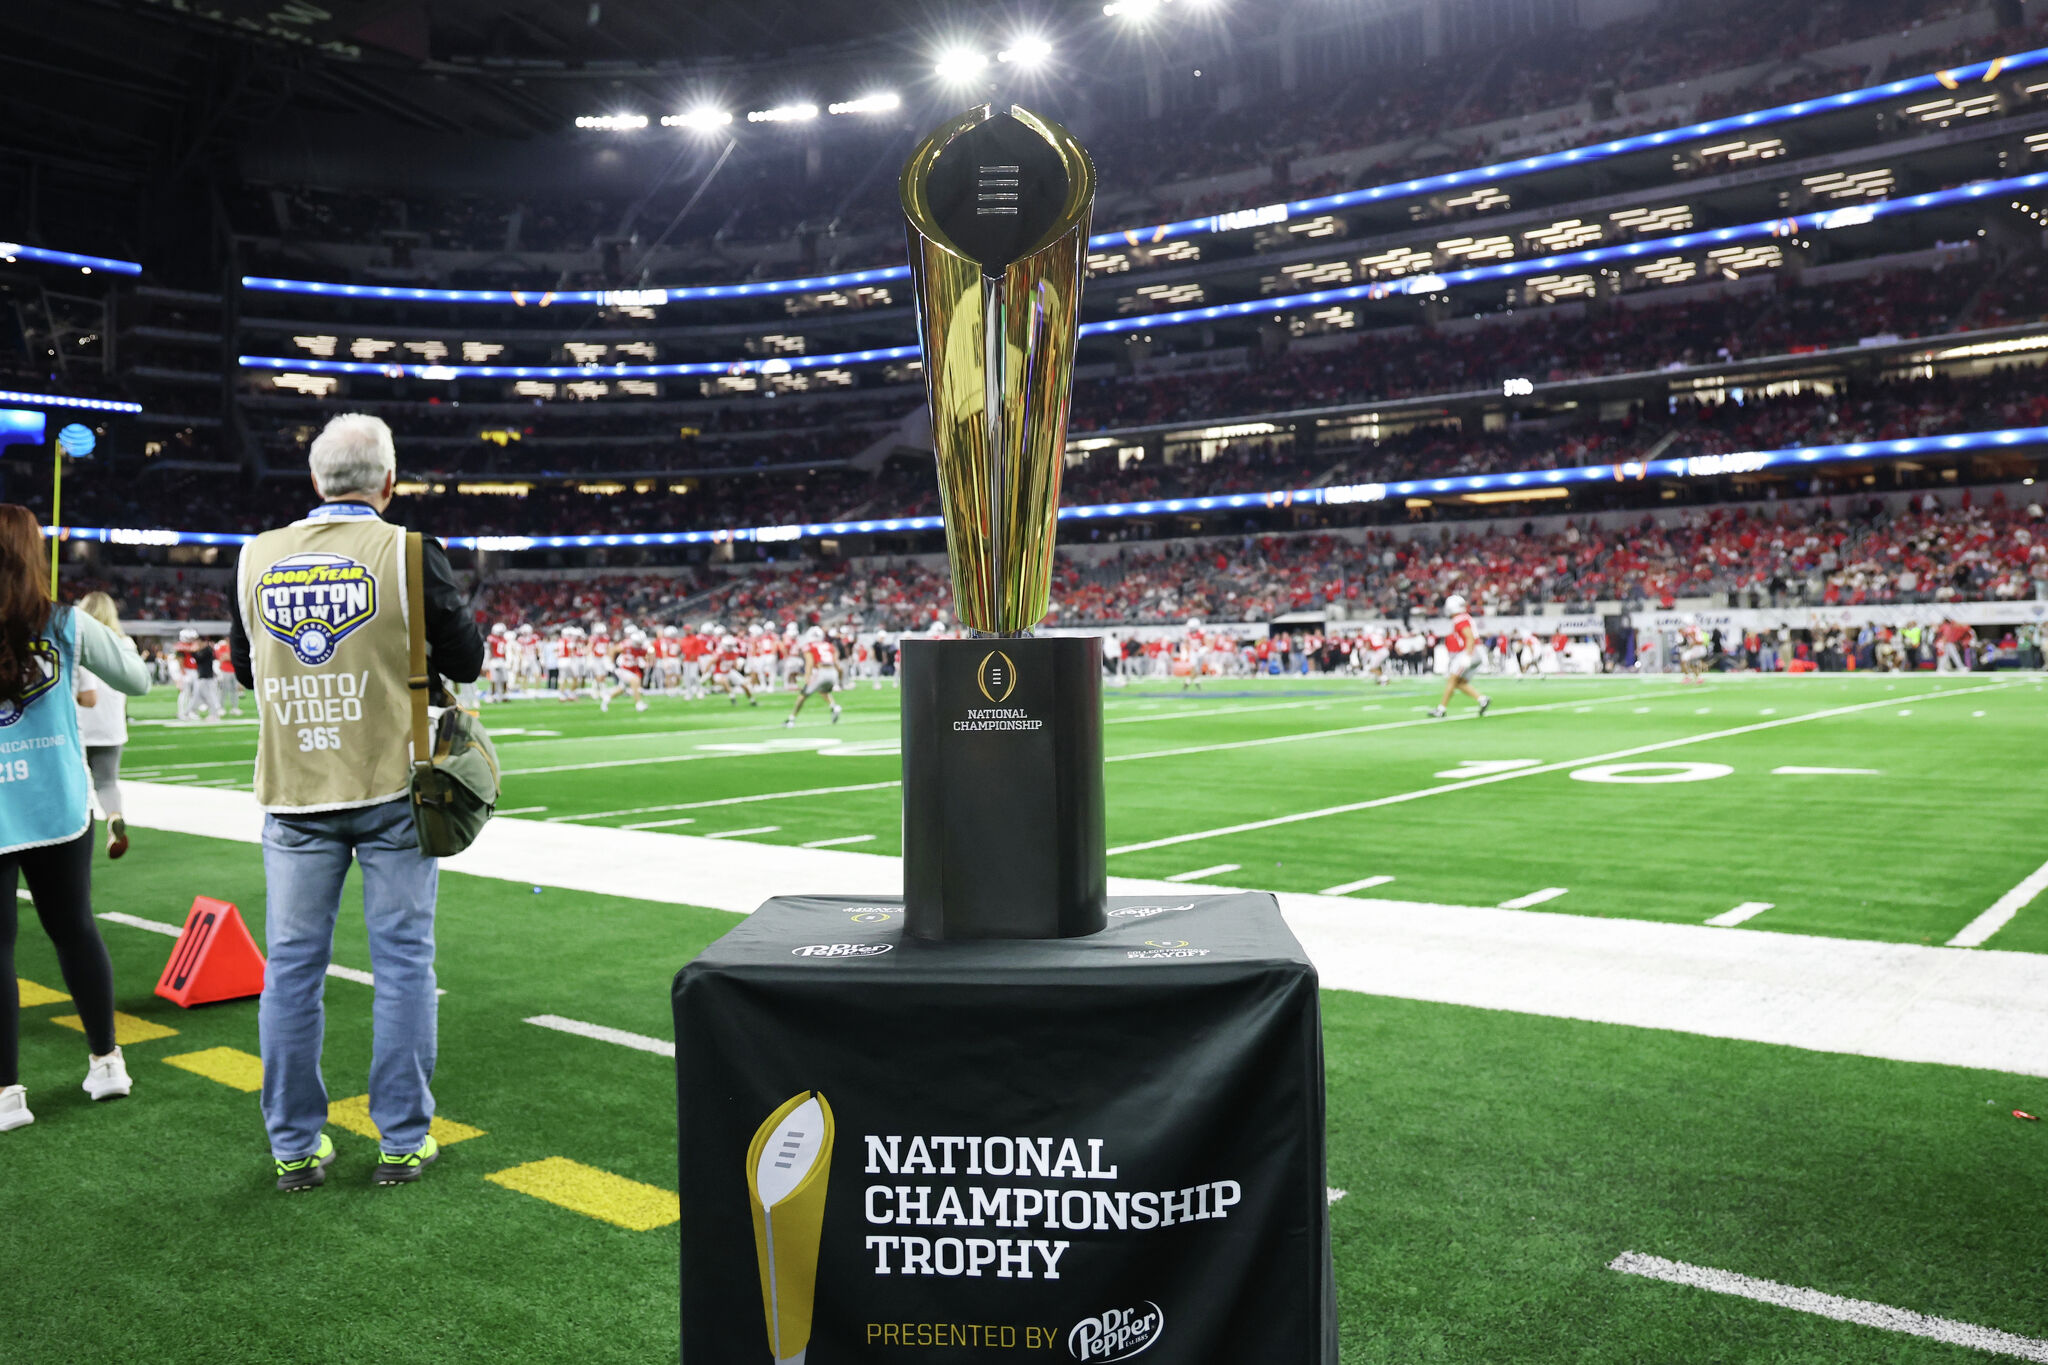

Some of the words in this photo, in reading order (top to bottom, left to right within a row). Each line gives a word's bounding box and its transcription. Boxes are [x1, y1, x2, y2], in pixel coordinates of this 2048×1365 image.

[261, 566, 365, 585] GOODYEAR
[261, 582, 367, 622] COTTON
[277, 604, 347, 628] BOWL
[263, 670, 369, 701] PHOTO/
[273, 698, 362, 726] VIDEO
[953, 720, 1042, 731] CHAMPIONSHIP
[968, 708, 1027, 720] NATIONAL
[297, 726, 342, 752] 365
[864, 1135, 1117, 1179] NATIONAL
[864, 1180, 1241, 1231] CHAMPIONSHIP
[865, 1235, 1070, 1280] TROPHY
[1102, 1307, 1135, 1335] Dr
[867, 1322, 1016, 1349] PRESENTED
[1025, 1325, 1058, 1350] BY
[1068, 1313, 1156, 1362] Pepper
